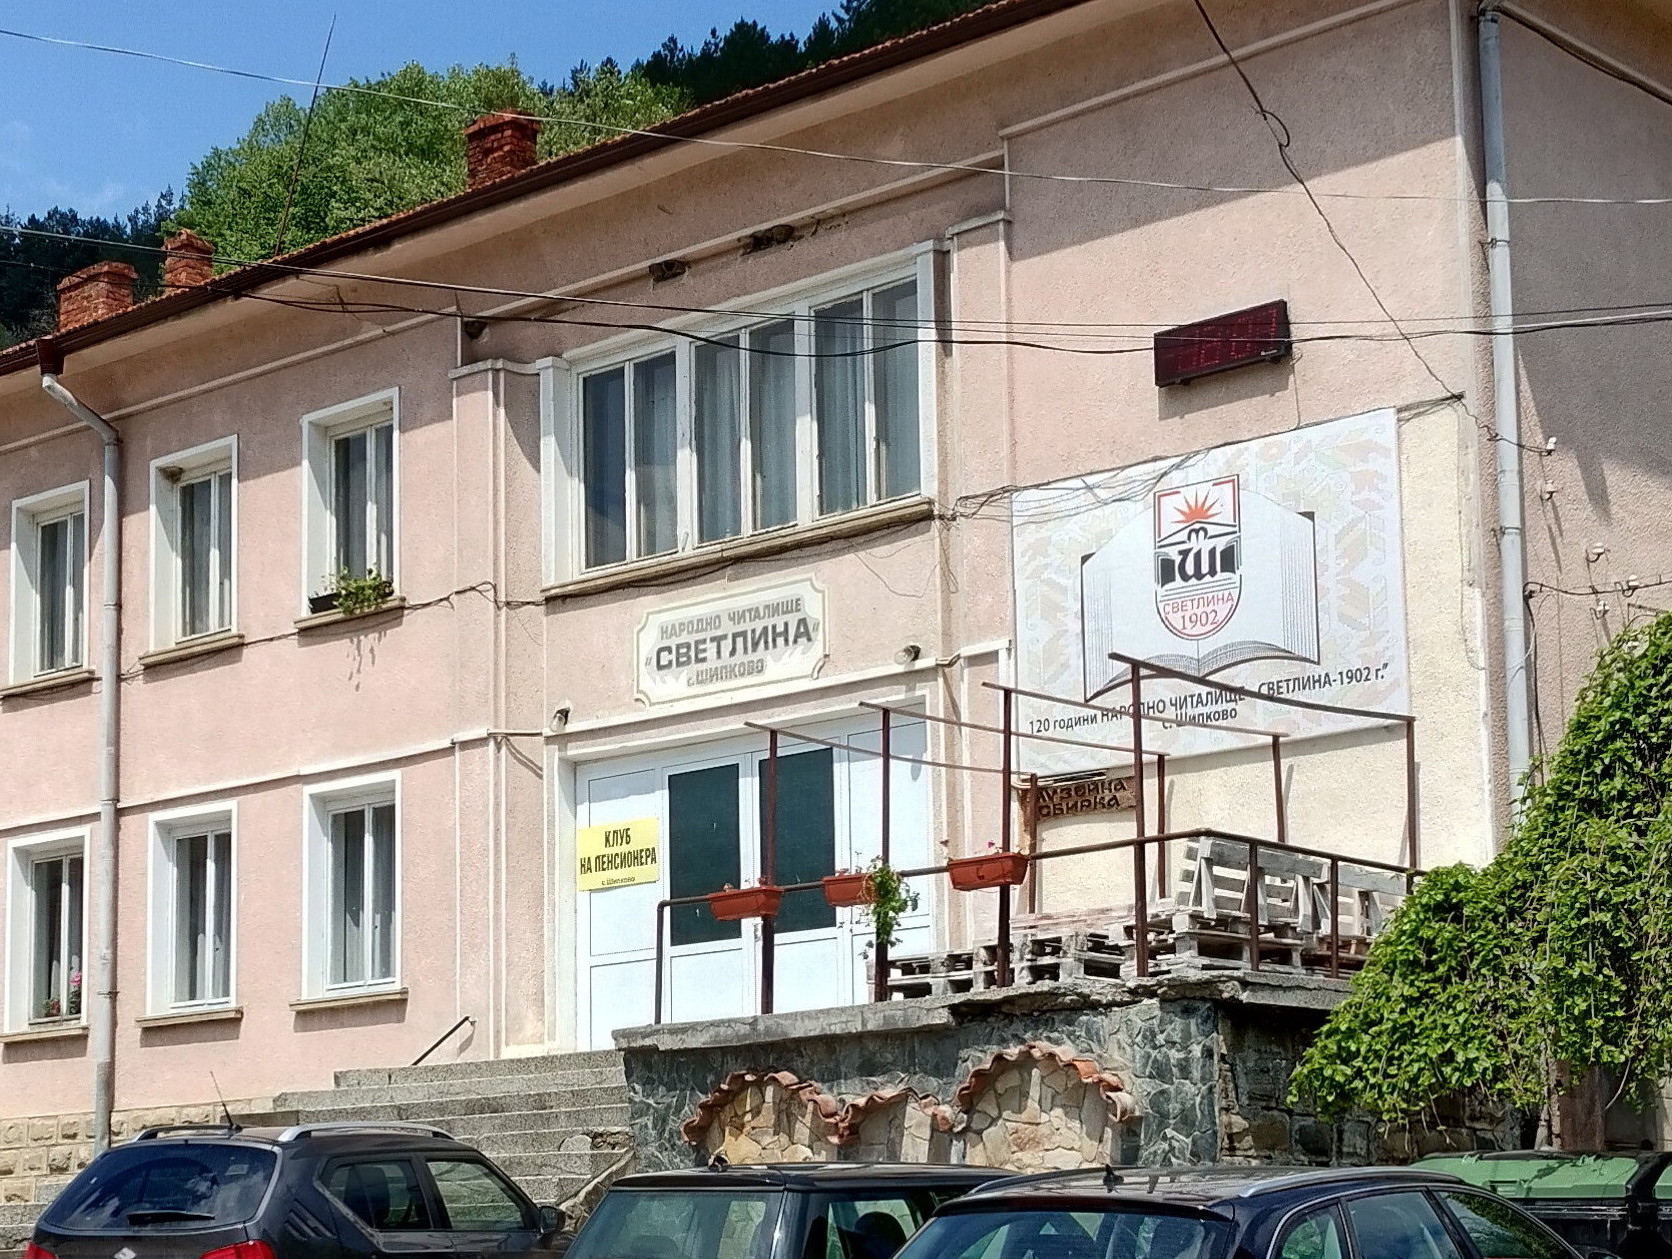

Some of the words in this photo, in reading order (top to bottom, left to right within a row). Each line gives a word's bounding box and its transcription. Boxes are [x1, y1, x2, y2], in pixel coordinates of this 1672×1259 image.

[1163, 591, 1234, 615] СВЕТЛИНА
[660, 614, 722, 641] НАРОДНО
[1180, 608, 1219, 631] 1902
[1029, 717, 1050, 734] 120
[1053, 713, 1097, 732] години
[1175, 707, 1238, 727] Шипково
[1039, 795, 1121, 817] СБИРКА
[604, 827, 631, 848] КЛУБ
[580, 856, 592, 875] НА
[594, 846, 657, 873] ПЕНСИОНЕРА
